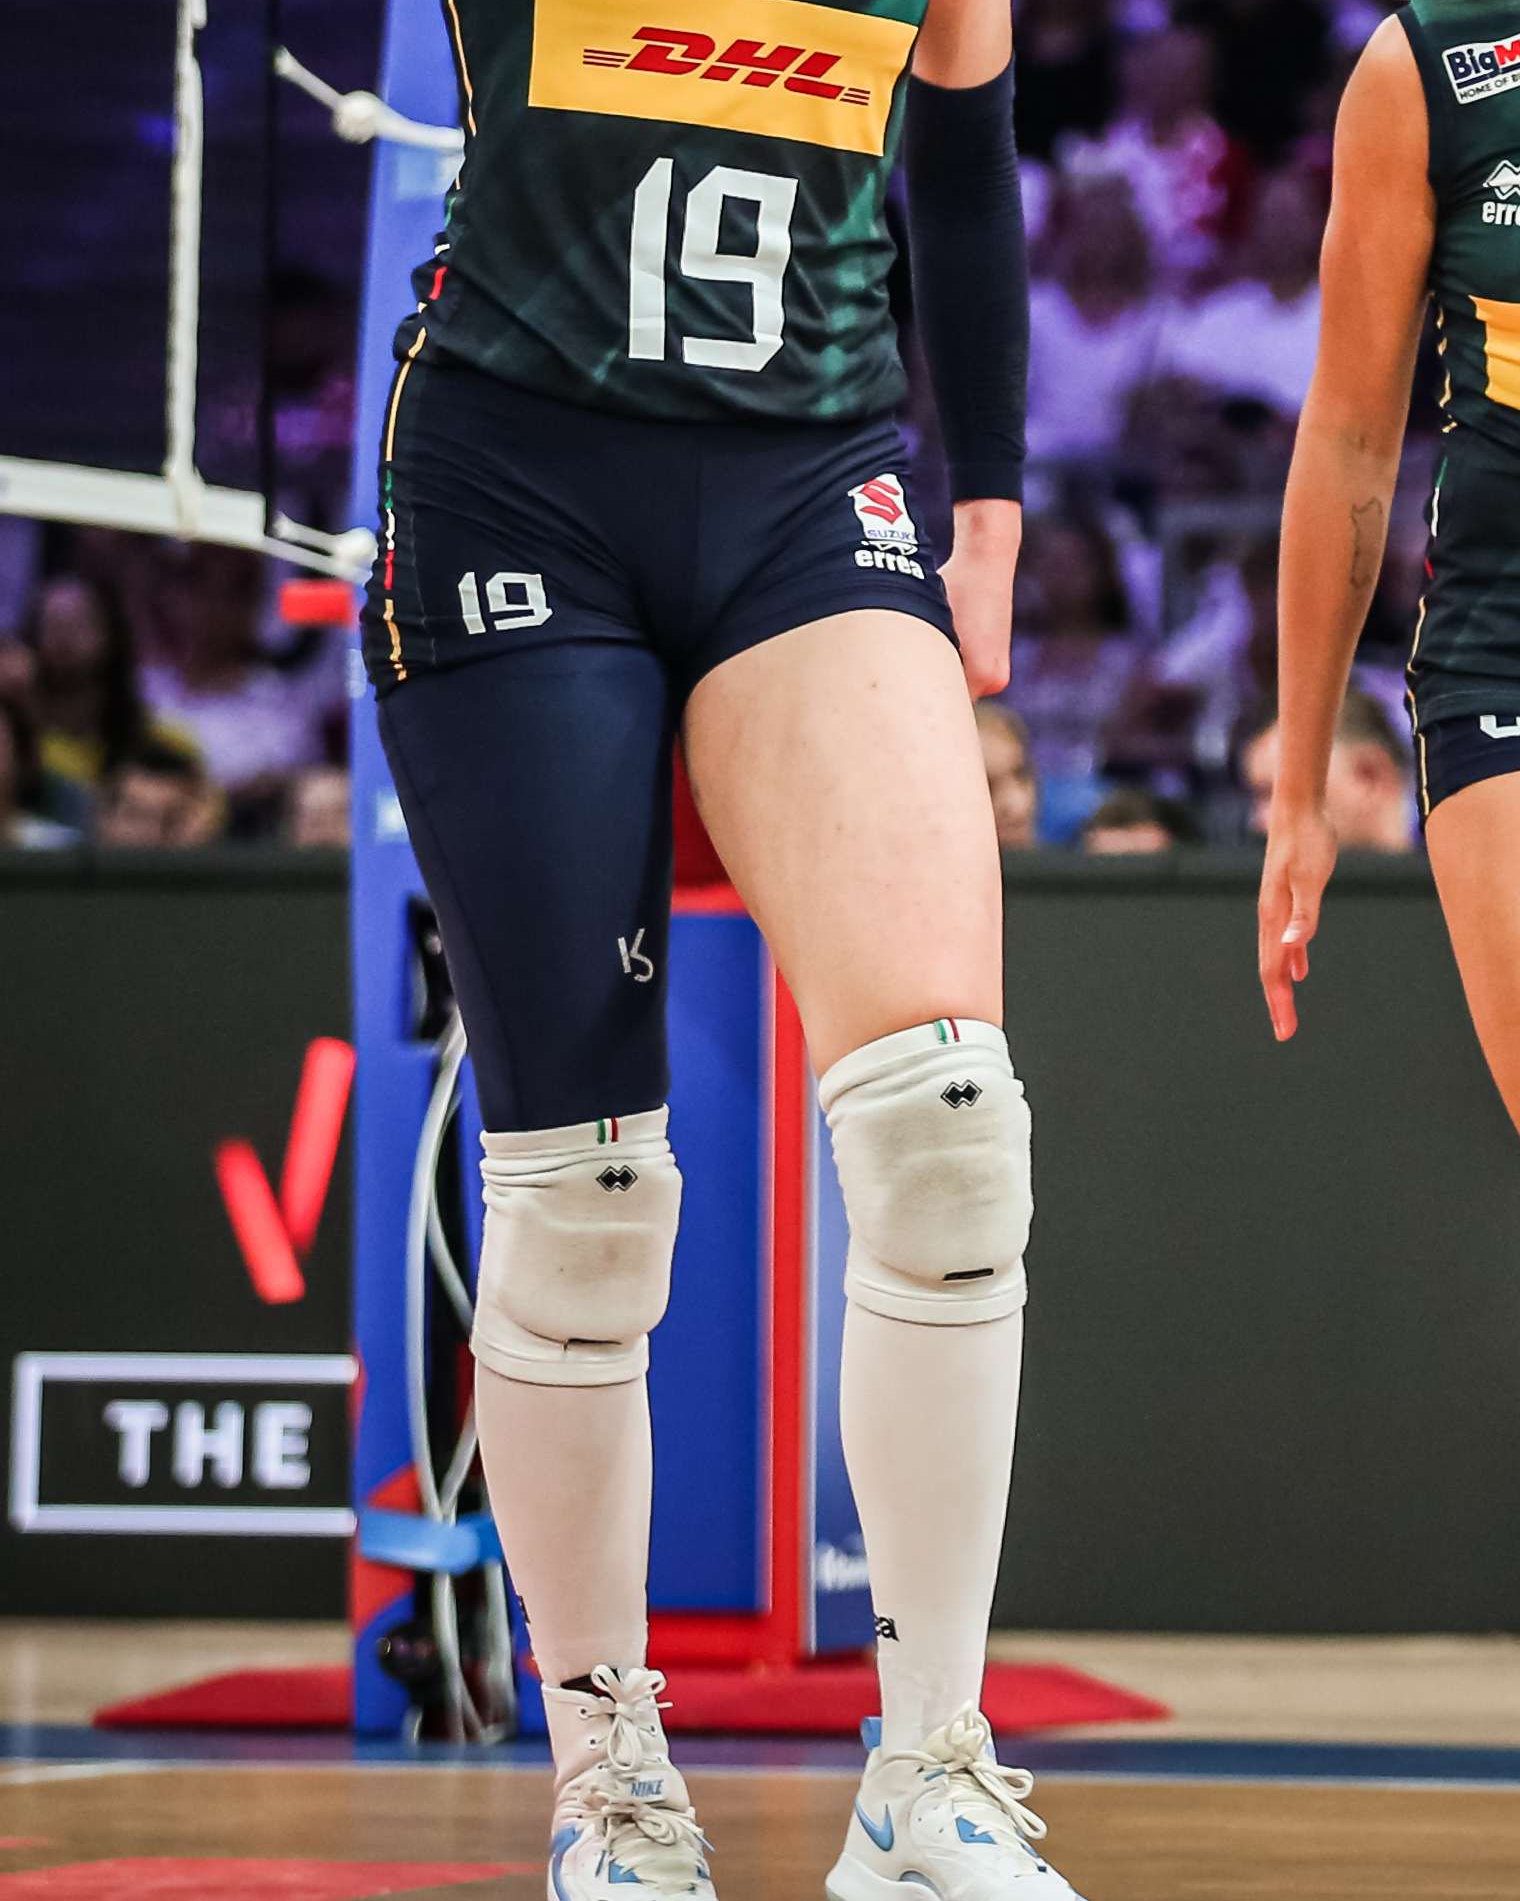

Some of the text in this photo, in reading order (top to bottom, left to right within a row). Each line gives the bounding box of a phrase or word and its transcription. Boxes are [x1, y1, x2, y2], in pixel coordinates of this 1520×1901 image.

[624, 26, 845, 100] DHL
[1460, 82, 1493, 100] HOME
[628, 157, 799, 372] 19
[854, 549, 925, 580] errea
[458, 571, 553, 634] 19
[103, 1400, 312, 1488] THE
[631, 1779, 664, 1797] NIKE
